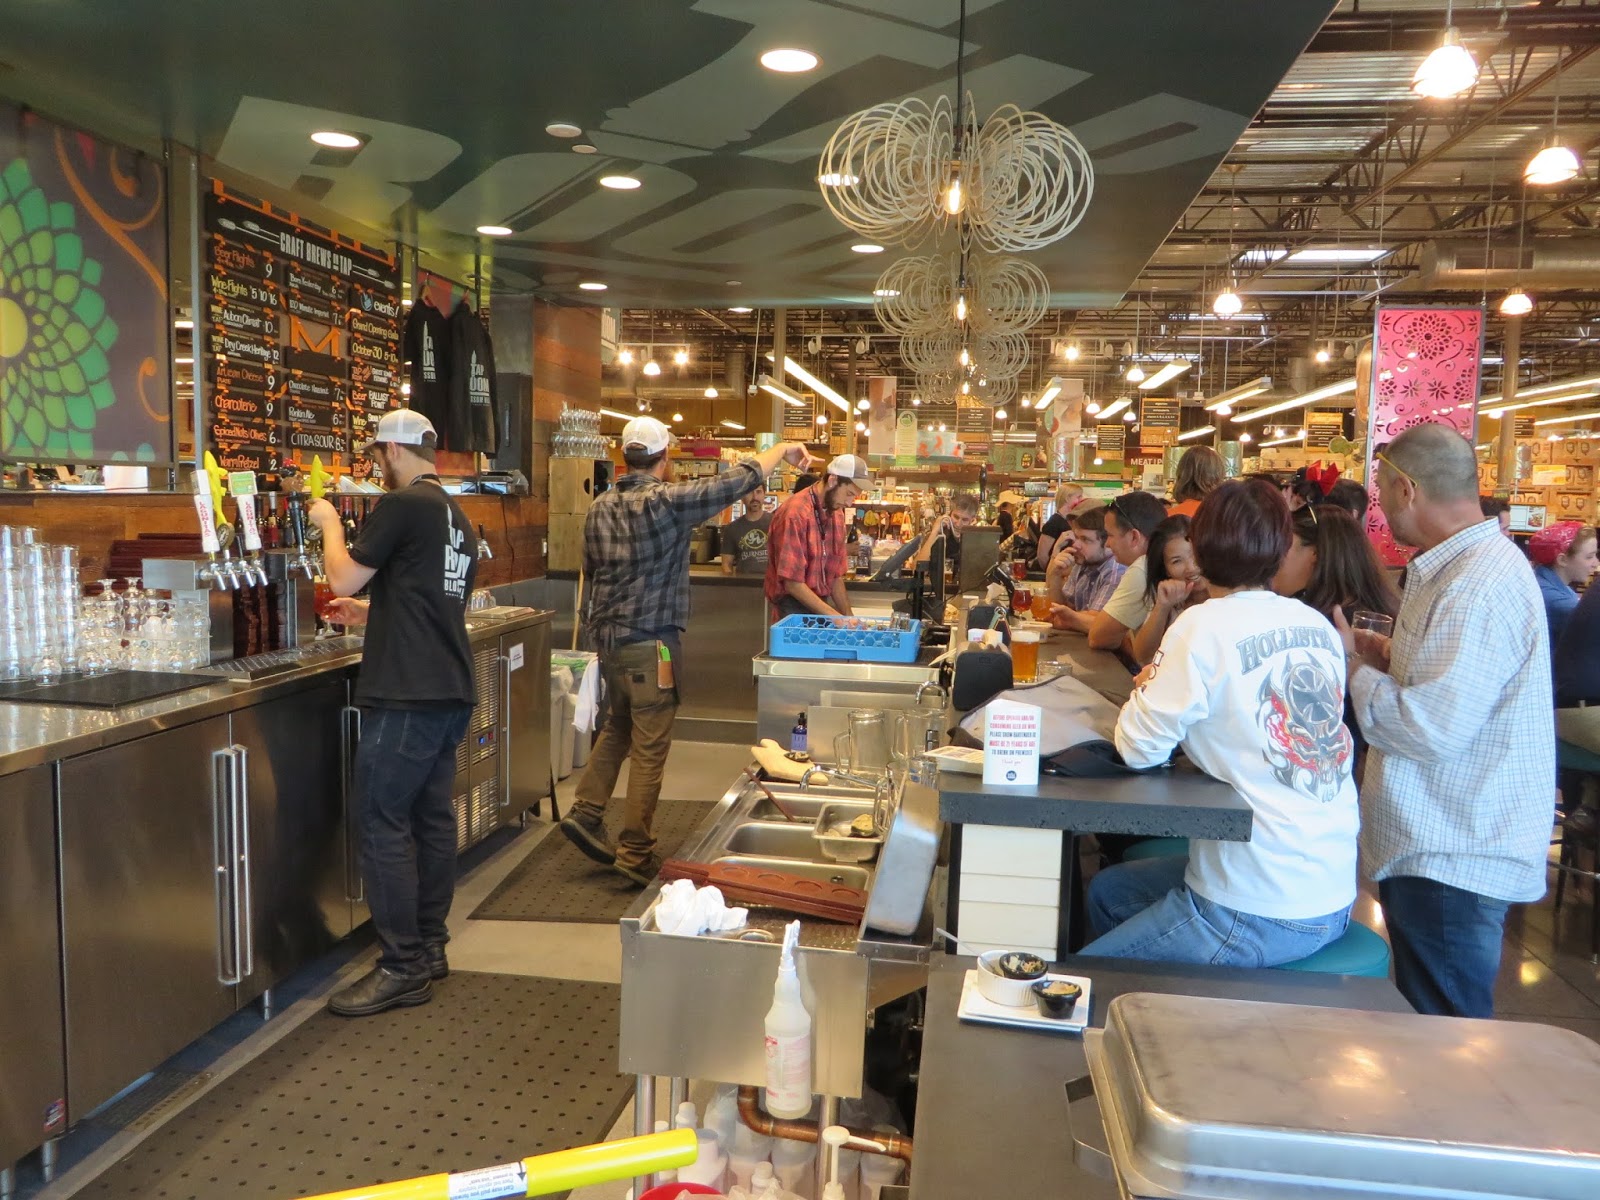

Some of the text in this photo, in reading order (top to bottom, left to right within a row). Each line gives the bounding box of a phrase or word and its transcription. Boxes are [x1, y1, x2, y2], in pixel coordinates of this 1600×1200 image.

[280, 232, 304, 258] CRAFT
[306, 242, 332, 269] BREWS
[340, 254, 352, 276] TAP
[373, 346, 382, 359] 30
[268, 376, 275, 390] 9
[267, 403, 273, 416] 9
